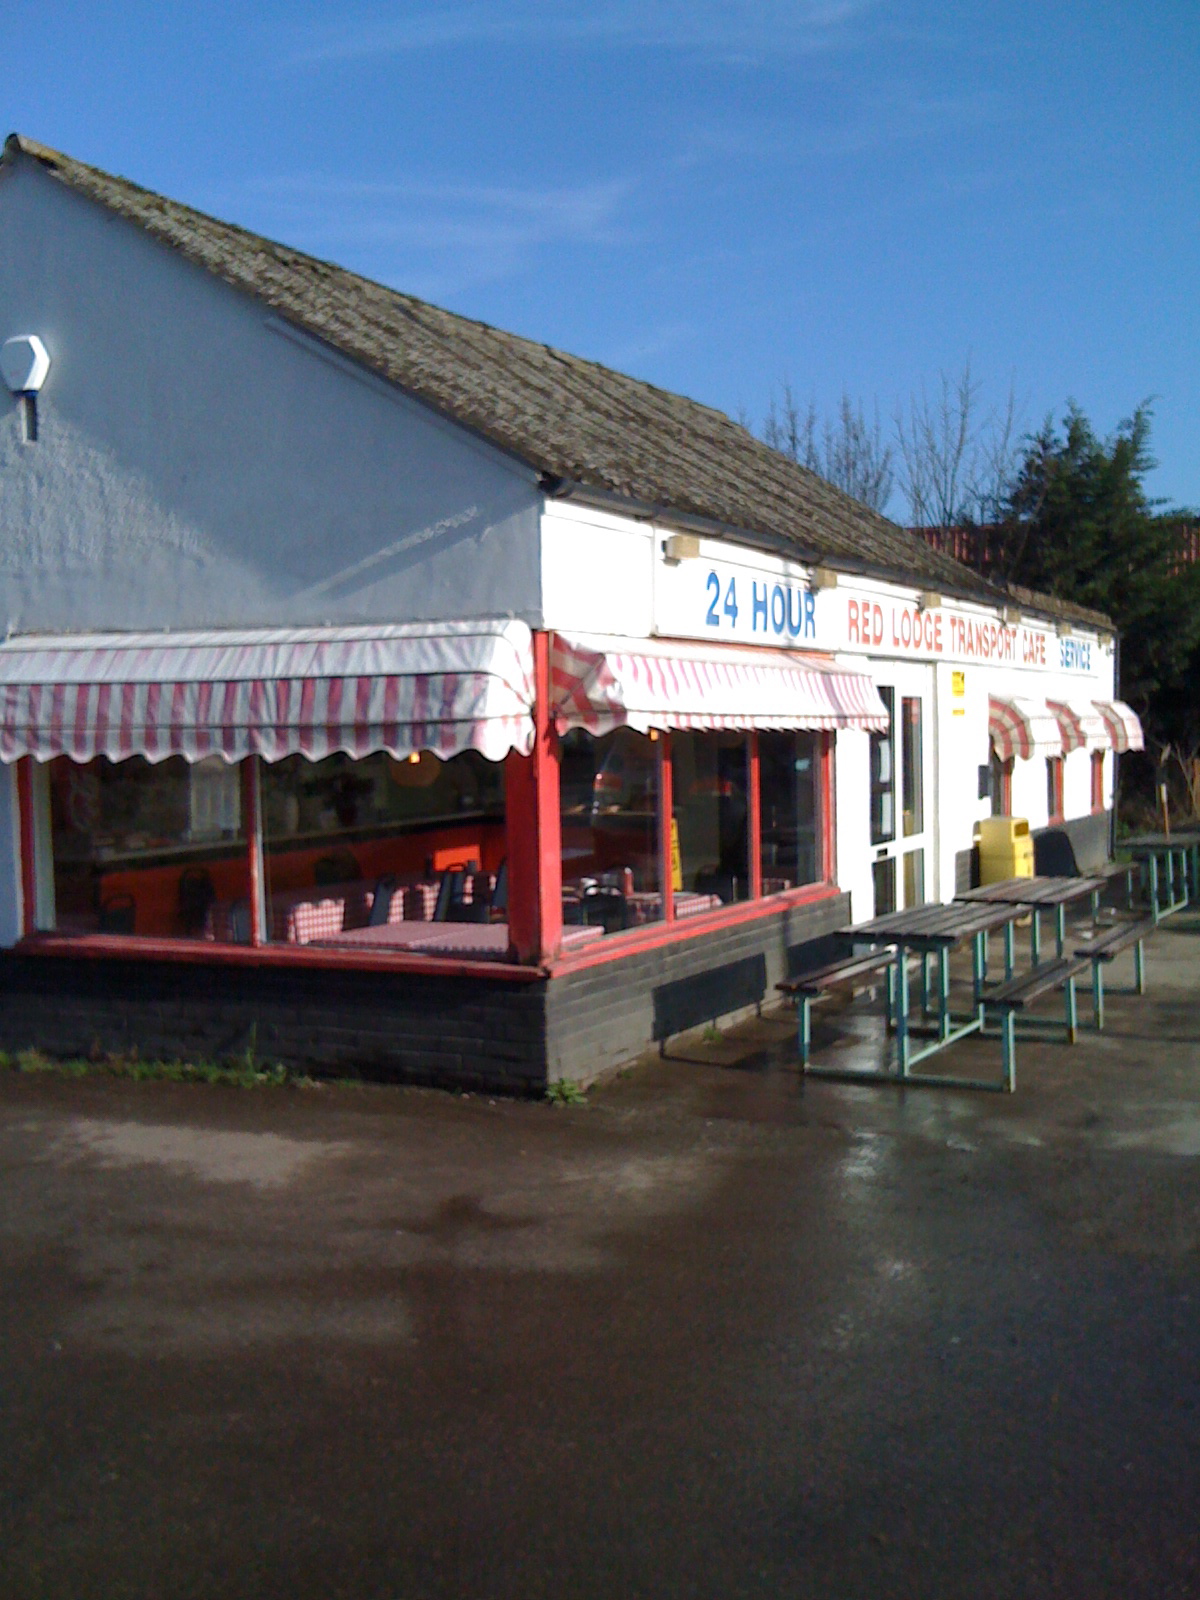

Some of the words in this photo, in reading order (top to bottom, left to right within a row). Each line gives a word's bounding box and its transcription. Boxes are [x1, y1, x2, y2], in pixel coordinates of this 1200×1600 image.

[706, 571, 739, 629] 24
[752, 580, 816, 639] HOUR
[848, 599, 883, 647] RED
[892, 607, 943, 653] LODGE
[949, 616, 1017, 661] TRANSPORT
